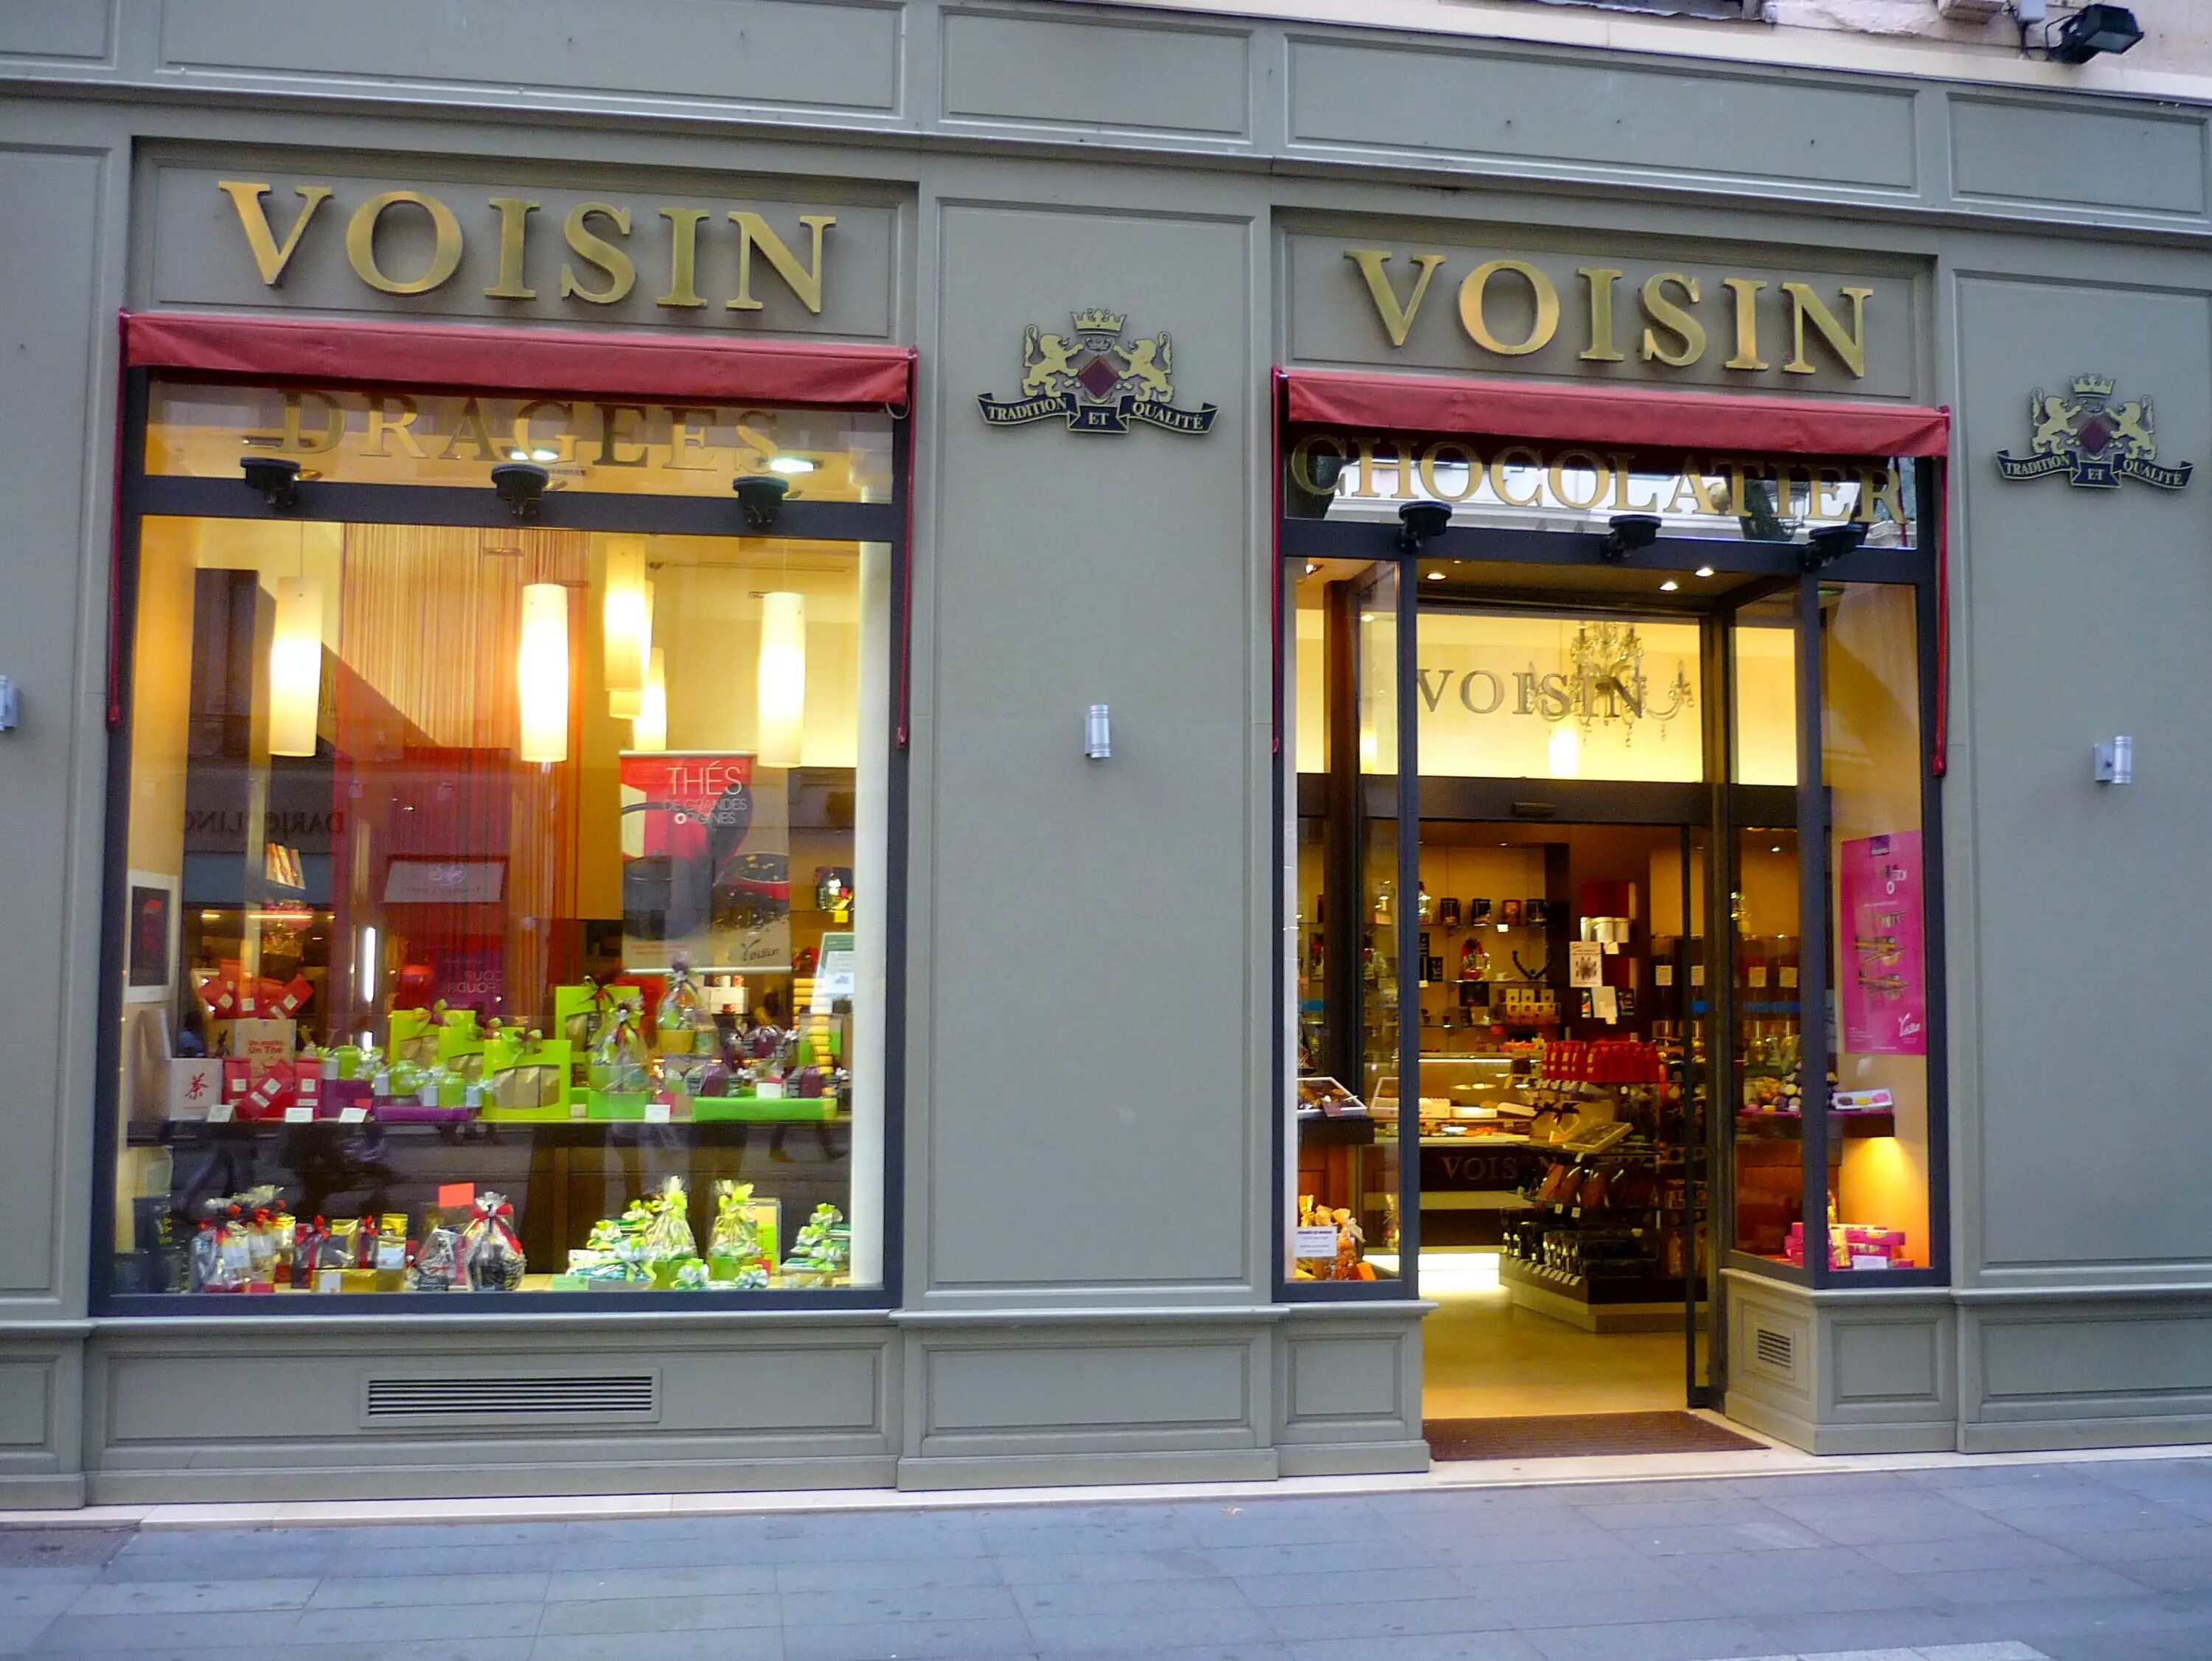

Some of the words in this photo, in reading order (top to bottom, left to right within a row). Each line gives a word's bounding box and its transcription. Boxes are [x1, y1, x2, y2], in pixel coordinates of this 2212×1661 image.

[218, 180, 836, 313] VOISIN
[1344, 248, 1874, 379] VOISIN
[987, 397, 1068, 420] TRADITION
[1088, 412, 1109, 426] ET
[1132, 402, 1203, 430] QUALITÉ
[276, 389, 779, 475] DRAGEES
[1290, 432, 1907, 525] CHOCOLATIER
[2004, 454, 2070, 475] TRADITION
[2087, 469, 2105, 480] ET
[2123, 460, 2183, 485] QUALITÉ
[1417, 669, 1648, 719] VOISIN
[666, 760, 742, 795] THÉS
[664, 798, 681, 811] DE
[685, 798, 748, 811] GRANDES
[675, 812, 737, 824] ORIGINES
[1441, 1155, 1557, 1180] VOISN
